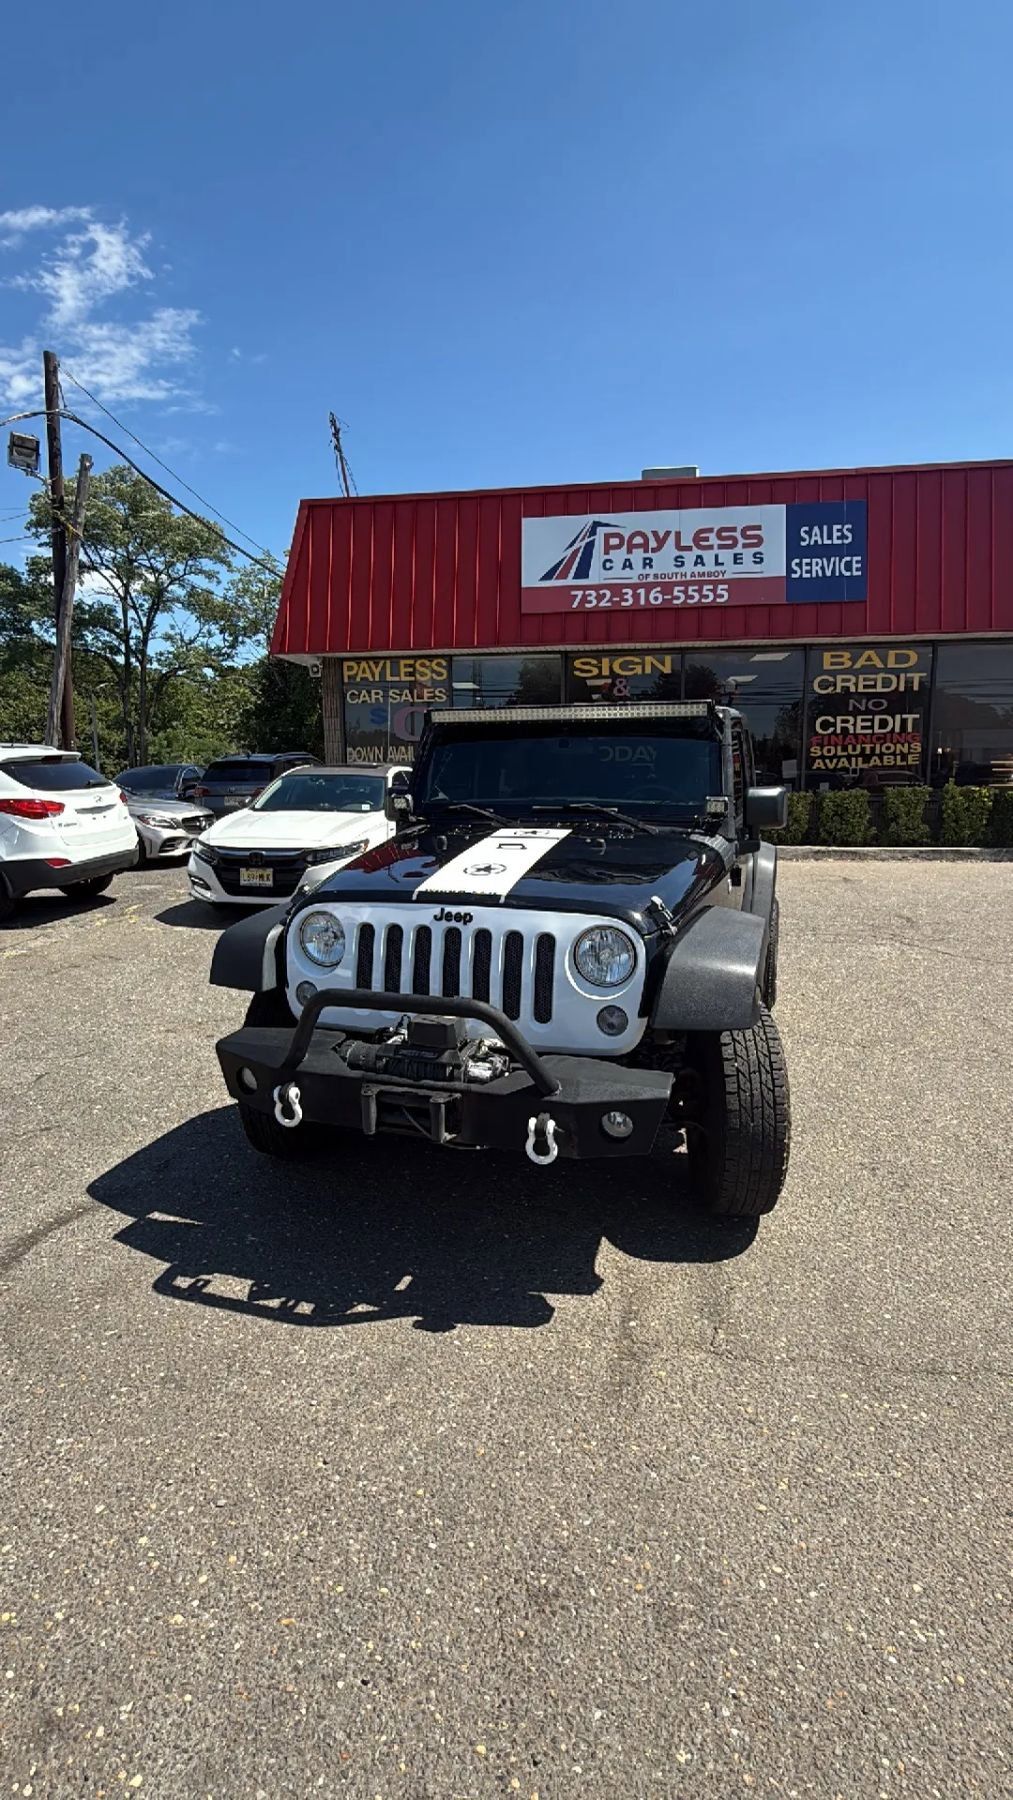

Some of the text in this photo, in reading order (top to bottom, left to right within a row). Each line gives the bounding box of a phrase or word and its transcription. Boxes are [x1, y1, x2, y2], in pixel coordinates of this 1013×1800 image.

[604, 525, 764, 555] PAYLESS
[800, 524, 853, 546] SALES
[602, 552, 764, 571] CAR SALES
[791, 556, 862, 578] SERVICE
[637, 570, 727, 581] OF SOUTH AMBOY
[570, 584, 729, 608] 732-316-5555
[573, 655, 672, 677] SIGN
[823, 650, 918, 670] BAD
[343, 658, 447, 683] PAYLESS
[612, 678, 630, 696] &
[813, 673, 927, 695] CREDIT
[347, 688, 447, 704] CAR SALES
[849, 699, 888, 711] NO
[815, 714, 920, 735] CREDIT
[810, 733, 921, 746] FINANCING
[347, 745, 415, 762] DOWN AVAIL
[599, 745, 656, 763] ODAY
[809, 742, 922, 757] SOLUTIONS
[812, 754, 920, 769] AVAILABLE
[433, 907, 473, 925] Jeep
